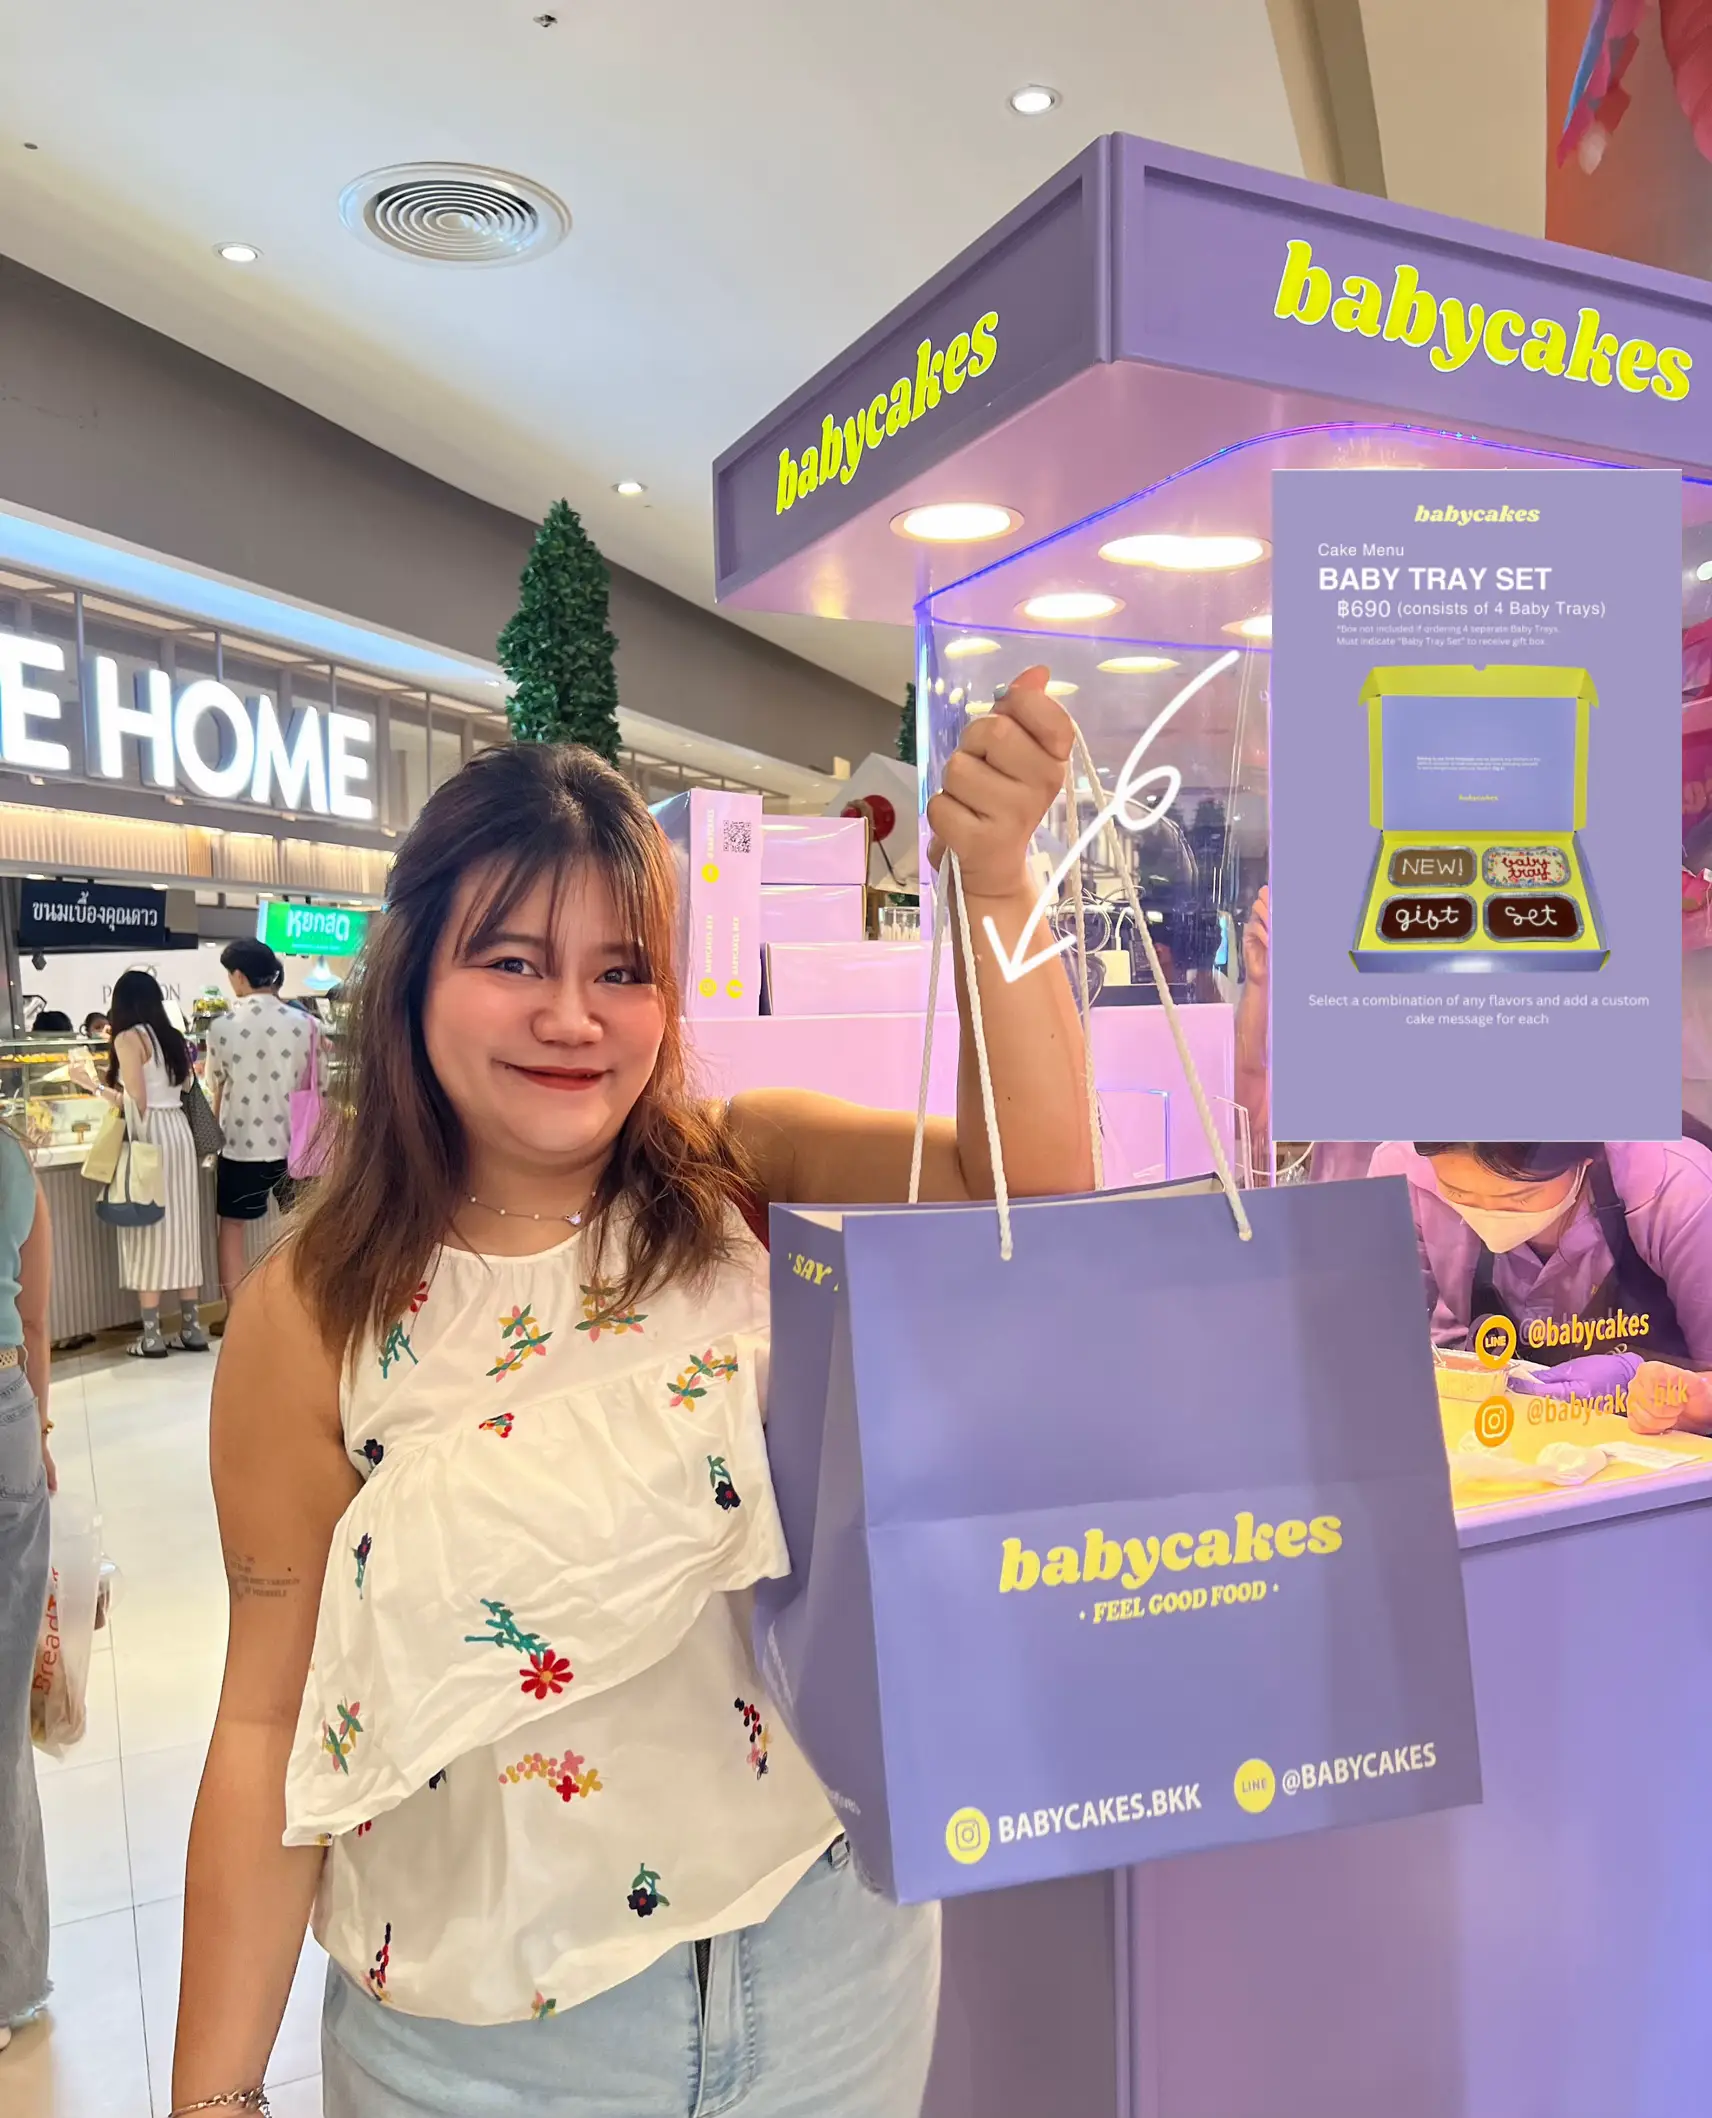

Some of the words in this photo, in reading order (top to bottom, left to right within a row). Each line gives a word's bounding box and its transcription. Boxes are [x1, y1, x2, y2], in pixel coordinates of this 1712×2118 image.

[1273, 239, 1692, 401] babycakes
[775, 312, 998, 515] babycakes
[94, 654, 374, 820] HOME
[32, 891, 159, 932] ขนมเบื้องคุณดาว
[1484, 1335, 1507, 1348] LINE
[1528, 1308, 1650, 1351] @babycakes
[999, 1511, 1343, 1593] babycakes
[1092, 1597, 1146, 1624] FEEL
[1148, 1587, 1209, 1614] GOOD
[1210, 1580, 1268, 1607] FOOD
[998, 1783, 1203, 1844] BABYCAKES.BKK
[1281, 1742, 1437, 1796] @BABYCAKES
